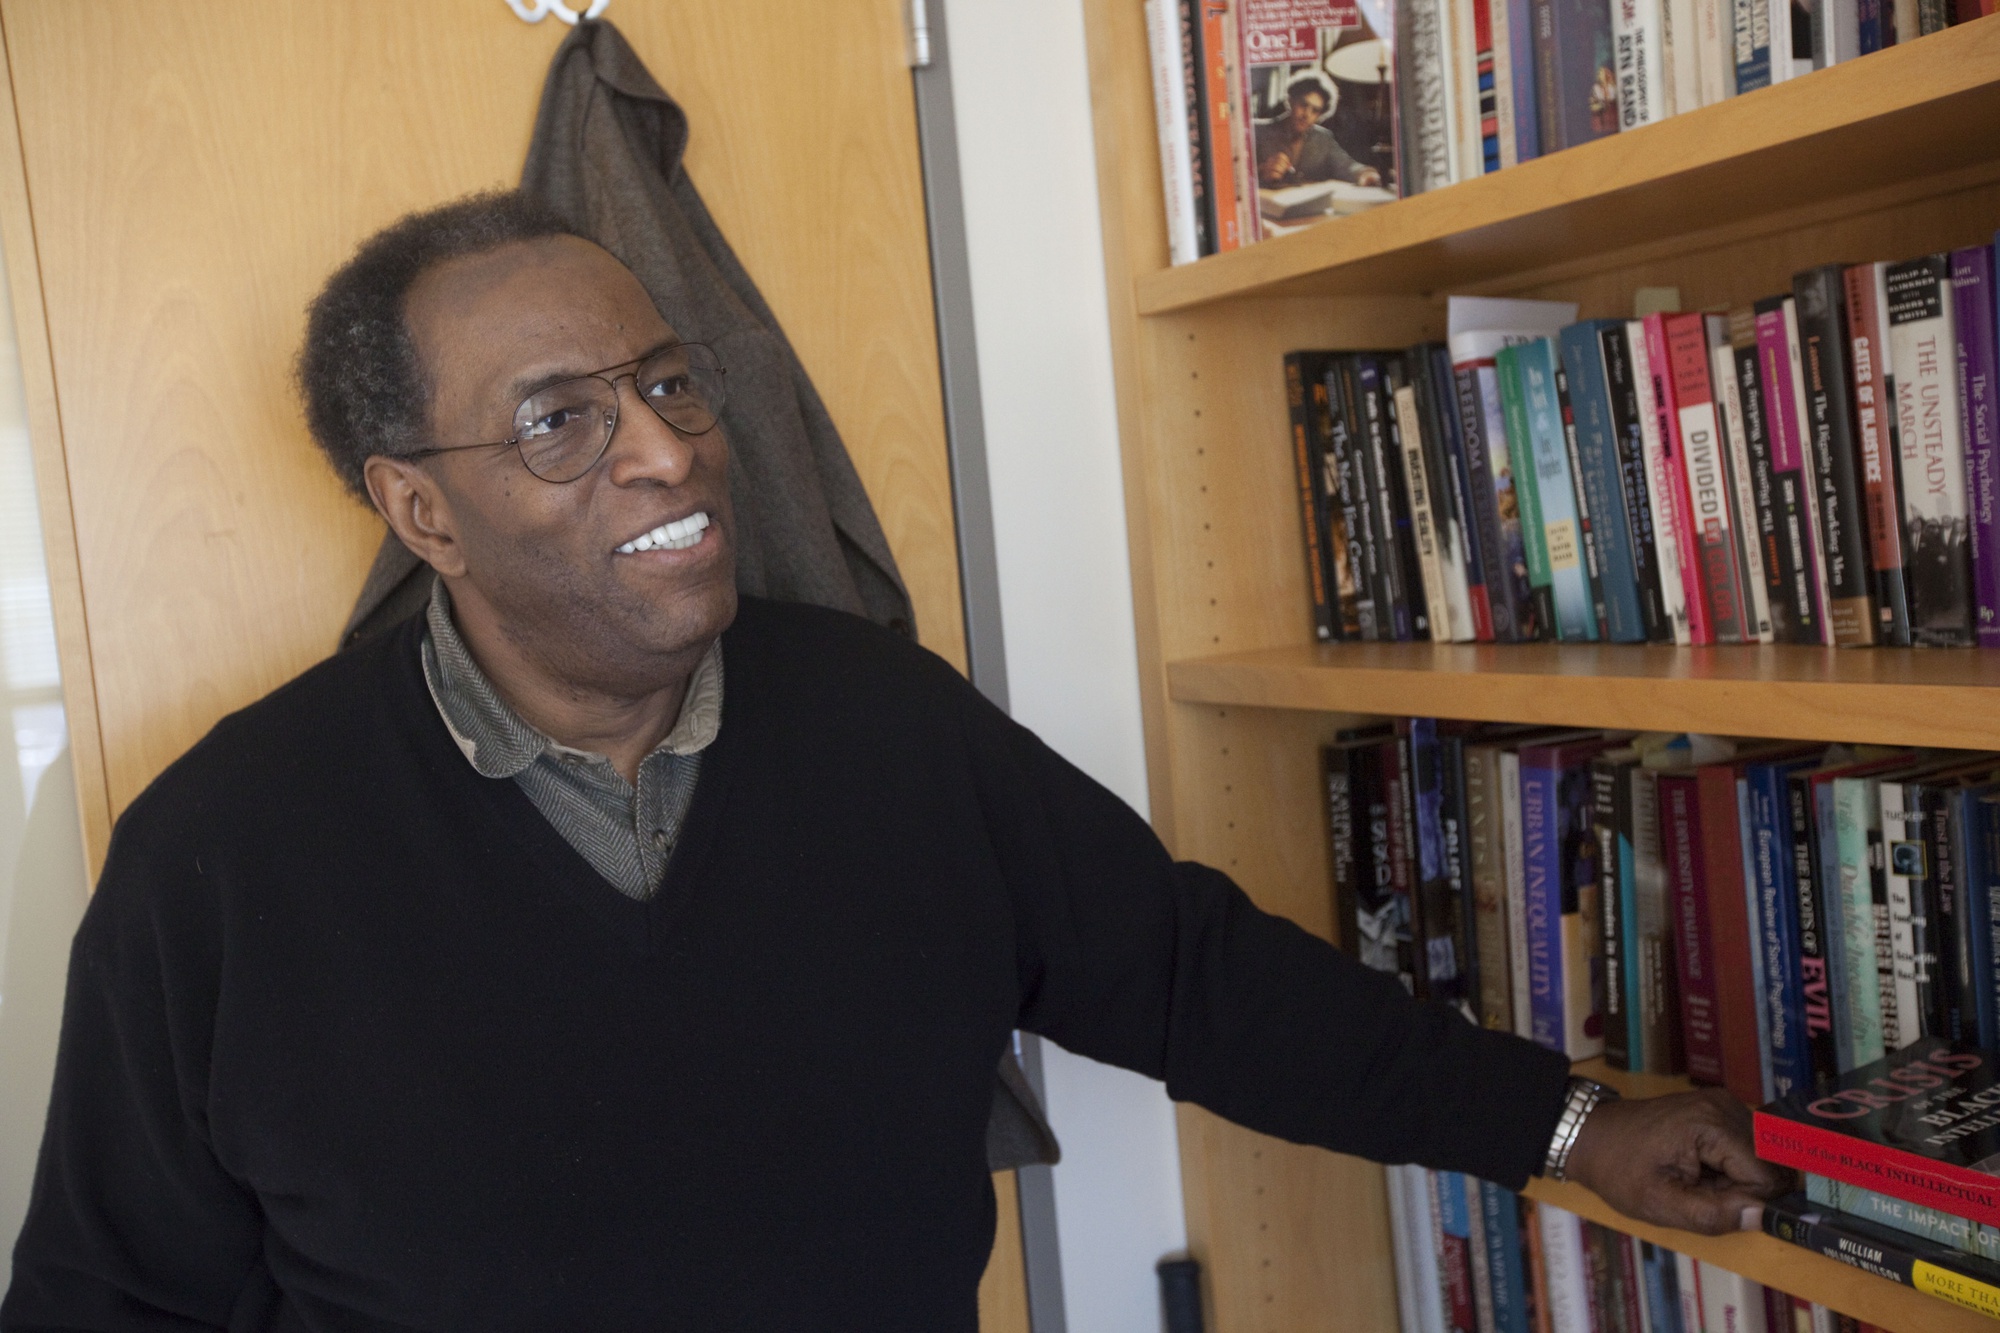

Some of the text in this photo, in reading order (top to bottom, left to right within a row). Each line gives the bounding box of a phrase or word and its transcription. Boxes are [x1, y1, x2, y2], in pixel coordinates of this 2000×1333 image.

[1246, 30, 1289, 51] One
[1617, 34, 1632, 69] AYN
[1621, 74, 1637, 127] RAND
[1853, 336, 1873, 382] GATES
[1456, 369, 1483, 471] FREEDOM
[1813, 392, 1828, 422] The
[1858, 385, 1876, 405] OF
[1917, 334, 1949, 497] THE UNSTEADY
[1959, 361, 1975, 456] Interpersonal
[1332, 421, 1348, 459] The
[1861, 407, 1882, 483] INJUSTICE
[1898, 381, 1918, 461] MARCH
[1814, 424, 1833, 475] Dignity
[1972, 373, 1996, 525] The Social Psychology
[1336, 460, 1352, 502] New
[1629, 424, 1654, 544] PSYCHOLOGY
[1822, 477, 1837, 493] of
[1342, 507, 1358, 539] Jim
[1622, 462, 1646, 569] LEGITIMACY
[1690, 430, 1733, 621] DIVIDED BY COLOR
[1822, 494, 1843, 554] Working
[1965, 459, 1982, 560] Discrimination
[1347, 541, 1364, 592] Crow
[1446, 818, 1461, 890] POLICE
[1757, 829, 1774, 885] European
[1795, 842, 1810, 877] THE
[1935, 807, 1955, 915] Trust in the Law
[1524, 780, 1551, 1000] URBAN INEQUALITY
[1762, 887, 1777, 929] Review
[1798, 879, 1815, 930] ROOTS
[1892, 893, 1906, 904] The
[1766, 930, 1780, 944] of
[1767, 945, 1782, 980] Social
[1801, 932, 1817, 953] OF
[1769, 981, 1787, 1049] Psychology
[1800, 955, 1831, 1039] EVIL
[1806, 1049, 1983, 1120] CRISIS
[1760, 1130, 1997, 1209] CRISIS of the BLACK INTELLECTUAL
[1869, 1196, 2000, 1248] THE IMPACT OF
[1838, 1237, 1884, 1263] WILLIAM
[1860, 1259, 1902, 1283] WILSON
[1924, 1271, 2000, 1309] MORE THA
